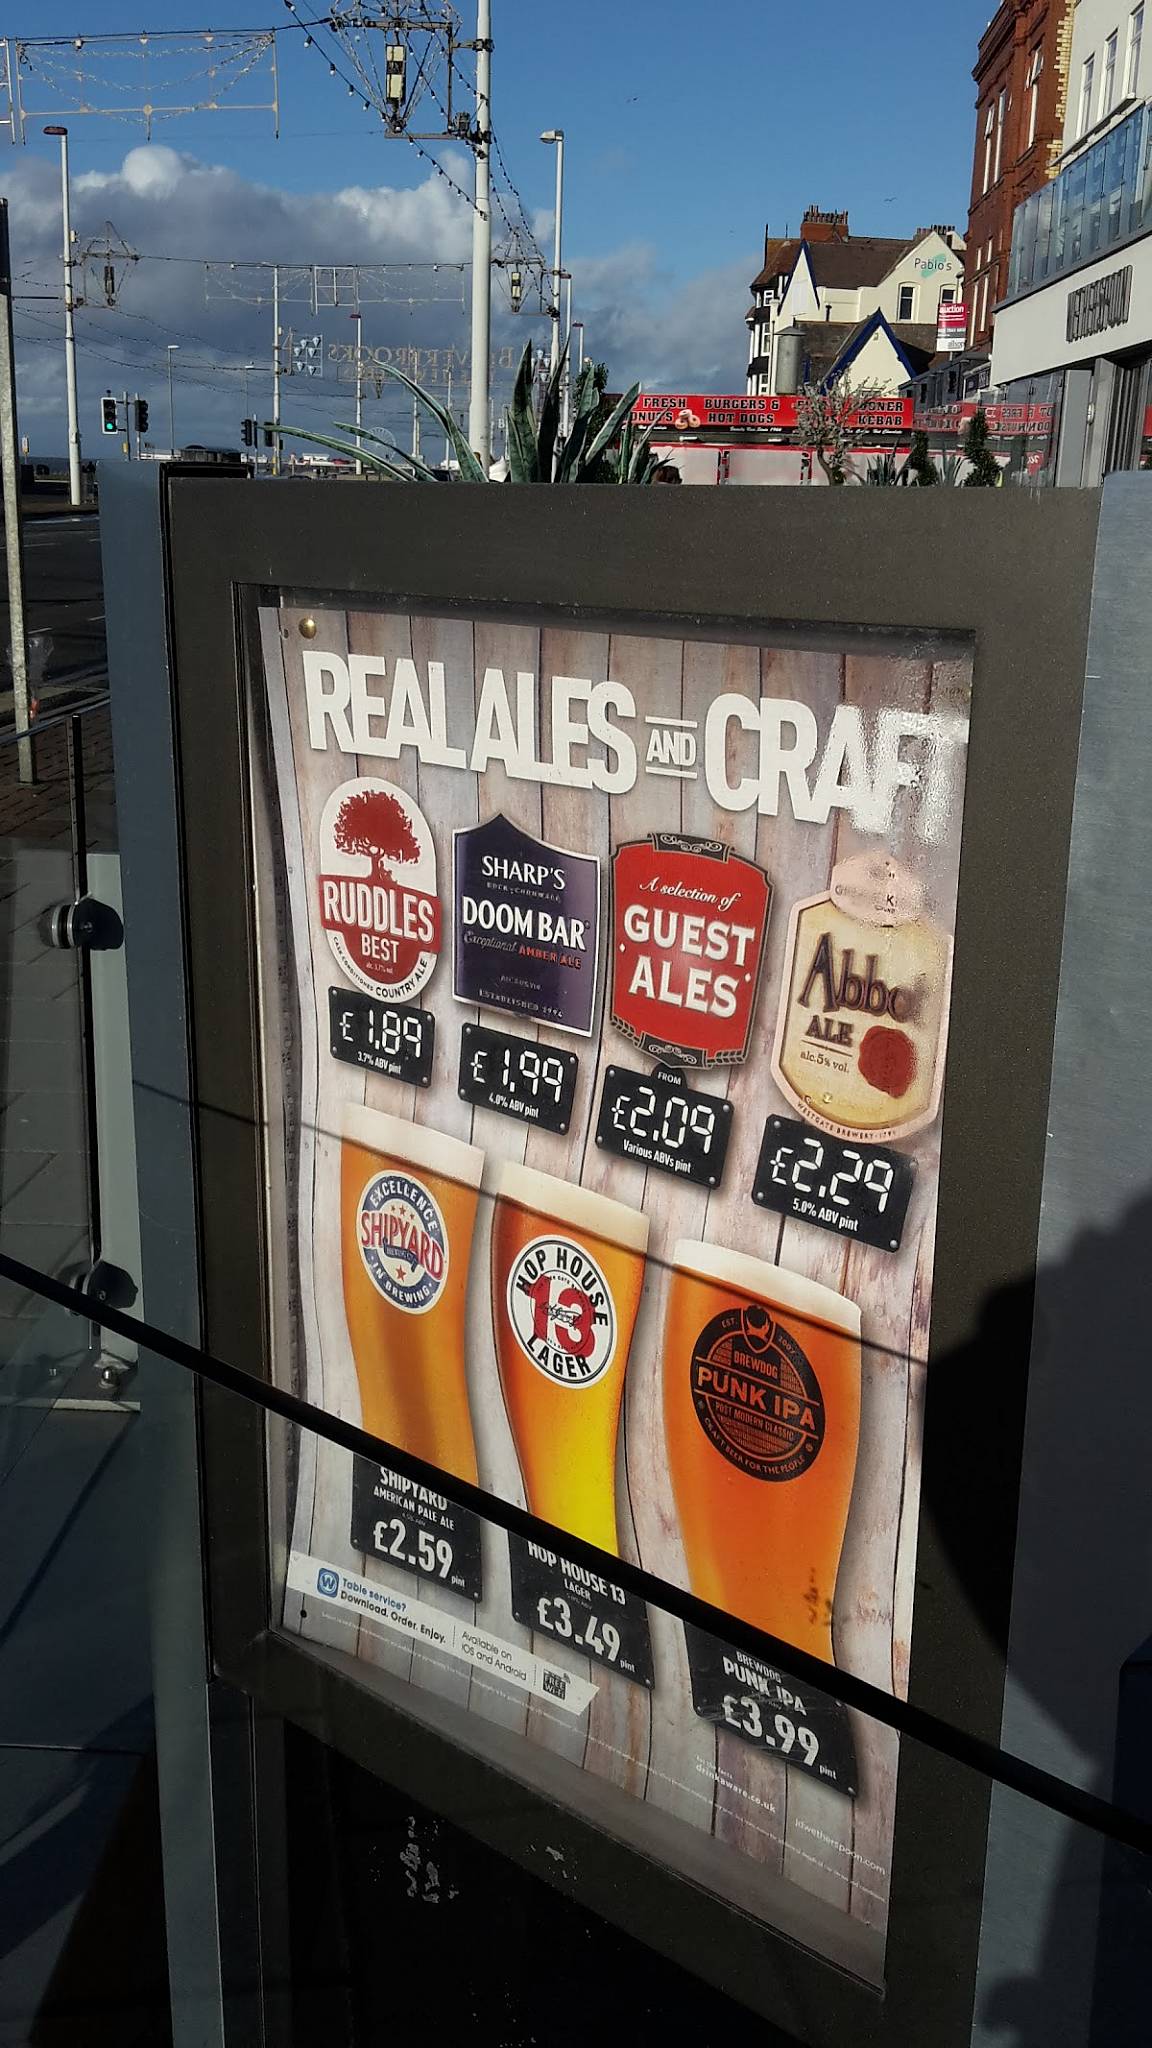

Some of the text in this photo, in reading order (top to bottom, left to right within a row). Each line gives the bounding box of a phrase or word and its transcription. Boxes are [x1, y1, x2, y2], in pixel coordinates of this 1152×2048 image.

[914, 257, 952, 271] Pablo's
[643, 398, 686, 408] FRESH
[704, 399, 780, 410] BURGERS &
[708, 413, 774, 424] HOT DOGS
[858, 415, 903, 426] KEBAB
[302, 650, 970, 844] REAL ALES AND CRAFT
[482, 855, 566, 890] SHARP'S
[323, 880, 435, 944] RUDDLES
[639, 876, 741, 912] A selection of
[462, 895, 586, 951] DOOM BAR
[623, 904, 755, 967] GUEST
[361, 933, 399, 963] BEST
[518, 945, 558, 963] AMBER
[559, 954, 582, 970] ALE
[375, 979, 416, 998] COUNTRY
[414, 958, 428, 983] ALE
[628, 954, 740, 1018] ALES
[797, 931, 920, 1024] Abbo
[339, 1009, 422, 1058] £1.89
[805, 1014, 854, 1047] ALE
[357, 1051, 401, 1075] 3.7% ABV pint
[470, 1048, 564, 1103] £1.99
[657, 1071, 681, 1085] FROM
[488, 1092, 539, 1119] 4.0% ABV pint
[611, 1086, 715, 1154] £2.09
[836, 1127, 873, 1139] BREWERY
[623, 1138, 691, 1174] Various ABVs pint
[769, 1137, 894, 1213] £2.29
[369, 1179, 439, 1232] EXCELLENCE
[792, 1197, 859, 1232] 5.0% ABV pint
[361, 1211, 445, 1281] SHIPYARD
[371, 1261, 430, 1304] IN BREWING
[516, 1248, 546, 1297] HOP
[556, 1247, 609, 1327] HOUSE
[527, 1273, 596, 1358] 13
[526, 1332, 592, 1378] LAGER
[733, 1350, 779, 1379] BREWDOG
[697, 1365, 767, 1411] PUNK
[774, 1394, 816, 1431] IPA
[715, 1401, 732, 1417] POST
[733, 1409, 764, 1429] MODERN
[764, 1420, 795, 1442] CLASSIC
[744, 1459, 761, 1472] FOR
[762, 1465, 780, 1475] THE
[780, 1455, 805, 1474] PEOPLE
[373, 1485, 415, 1513] AMERICAN
[417, 1504, 438, 1523] PALE
[440, 1515, 455, 1531] ALE
[380, 1465, 448, 1511] SHIPYARD
[373, 1518, 454, 1579] £2.59
[451, 1574, 465, 1588] pint
[527, 1540, 557, 1567] HOP
[560, 1557, 608, 1597] HOUSE
[609, 1583, 626, 1606] 13
[564, 1578, 591, 1602] LAGER
[342, 1578, 407, 1612] Table service?
[340, 1590, 389, 1618] Download.
[390, 1611, 418, 1631] Order.
[420, 1624, 446, 1644] Enjoy.
[537, 1597, 621, 1662] £3.49
[462, 1631, 512, 1661] Available on
[462, 1643, 527, 1681] iOS and Android
[619, 1658, 636, 1674] pint
[722, 1656, 807, 1716] PUNK IPA
[736, 1651, 782, 1684] BREWDOG
[721, 1694, 820, 1767] £3.99
[695, 1763, 776, 1814] drinkaware.co.uk
[819, 1764, 837, 1780] pint
[795, 1817, 886, 1876] jdwetherspoon.com
